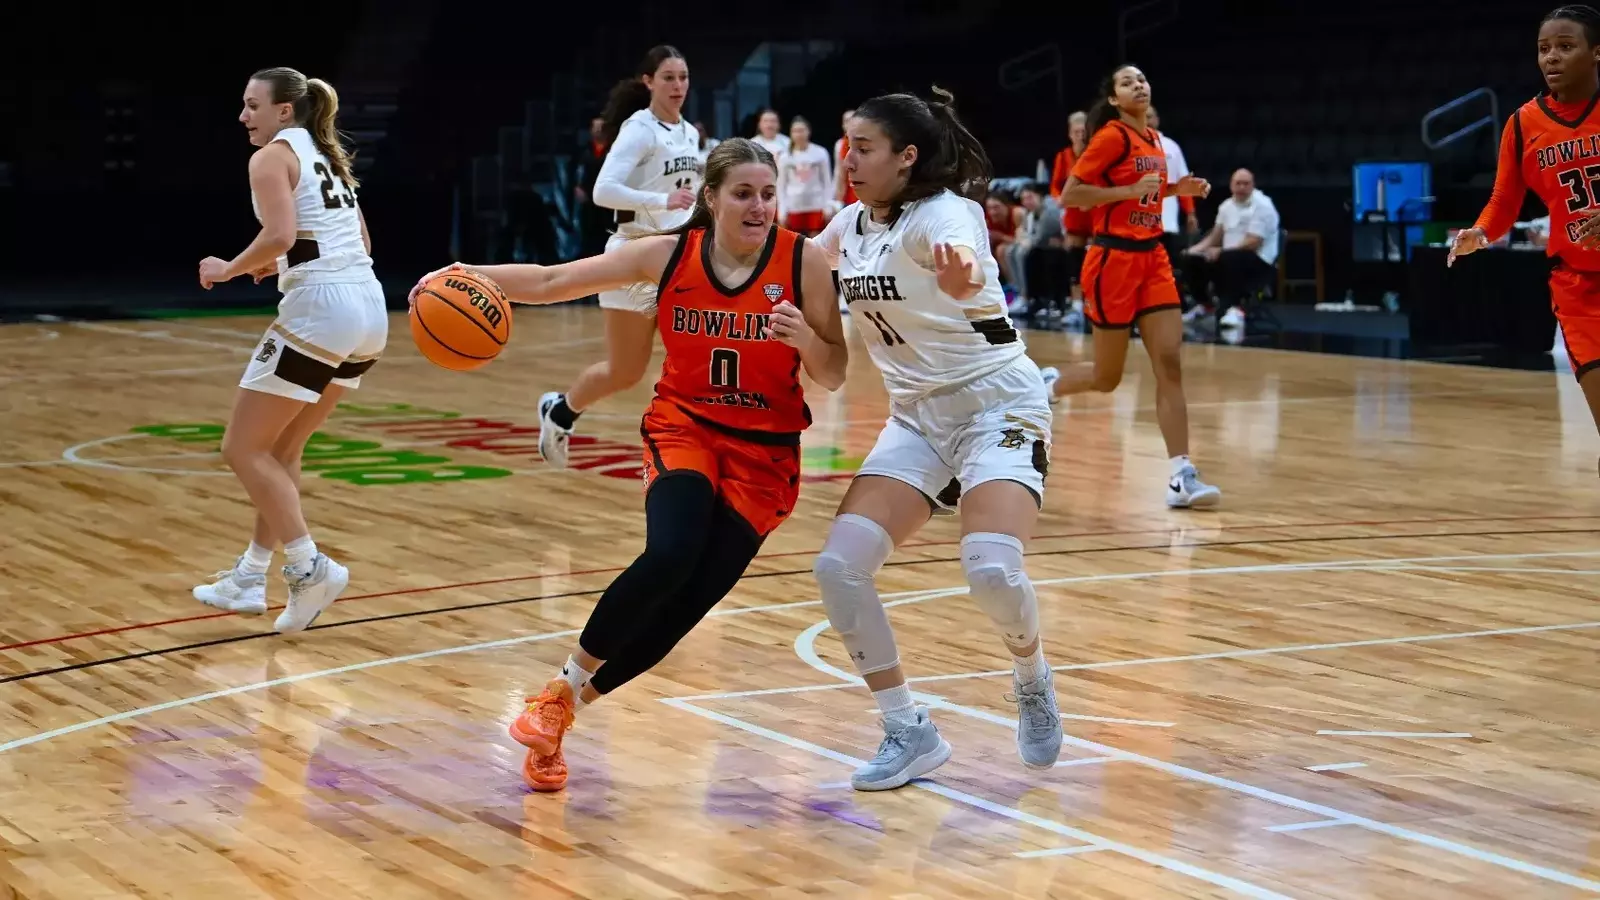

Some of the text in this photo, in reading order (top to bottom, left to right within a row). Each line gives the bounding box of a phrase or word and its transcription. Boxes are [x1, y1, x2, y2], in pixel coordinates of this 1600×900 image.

[1536, 134, 1600, 171] BOWLI
[444, 278, 502, 330] Wilson
[672, 306, 777, 341] BOWLIN
[709, 348, 740, 389] 0
